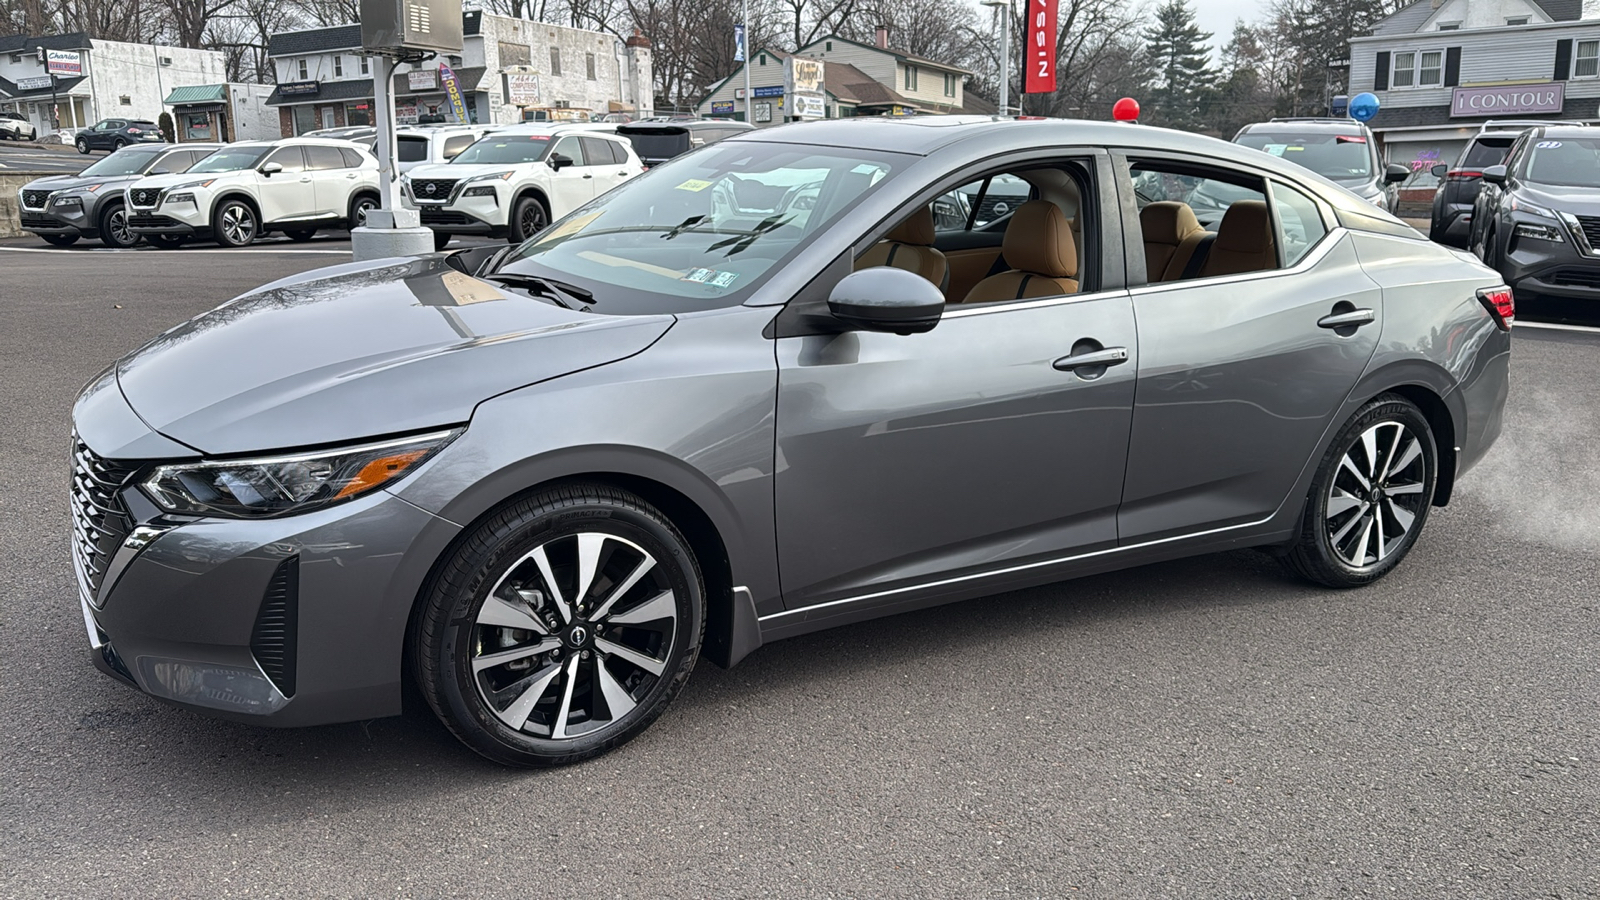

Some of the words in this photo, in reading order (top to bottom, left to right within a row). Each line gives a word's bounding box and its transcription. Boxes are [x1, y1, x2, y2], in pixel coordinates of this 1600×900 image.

[510, 82, 537, 90] COMPUTERS
[510, 96, 538, 104] 942-9700
[1469, 91, 1555, 109] CONTOUR
[560, 510, 597, 520] PRIMACY
